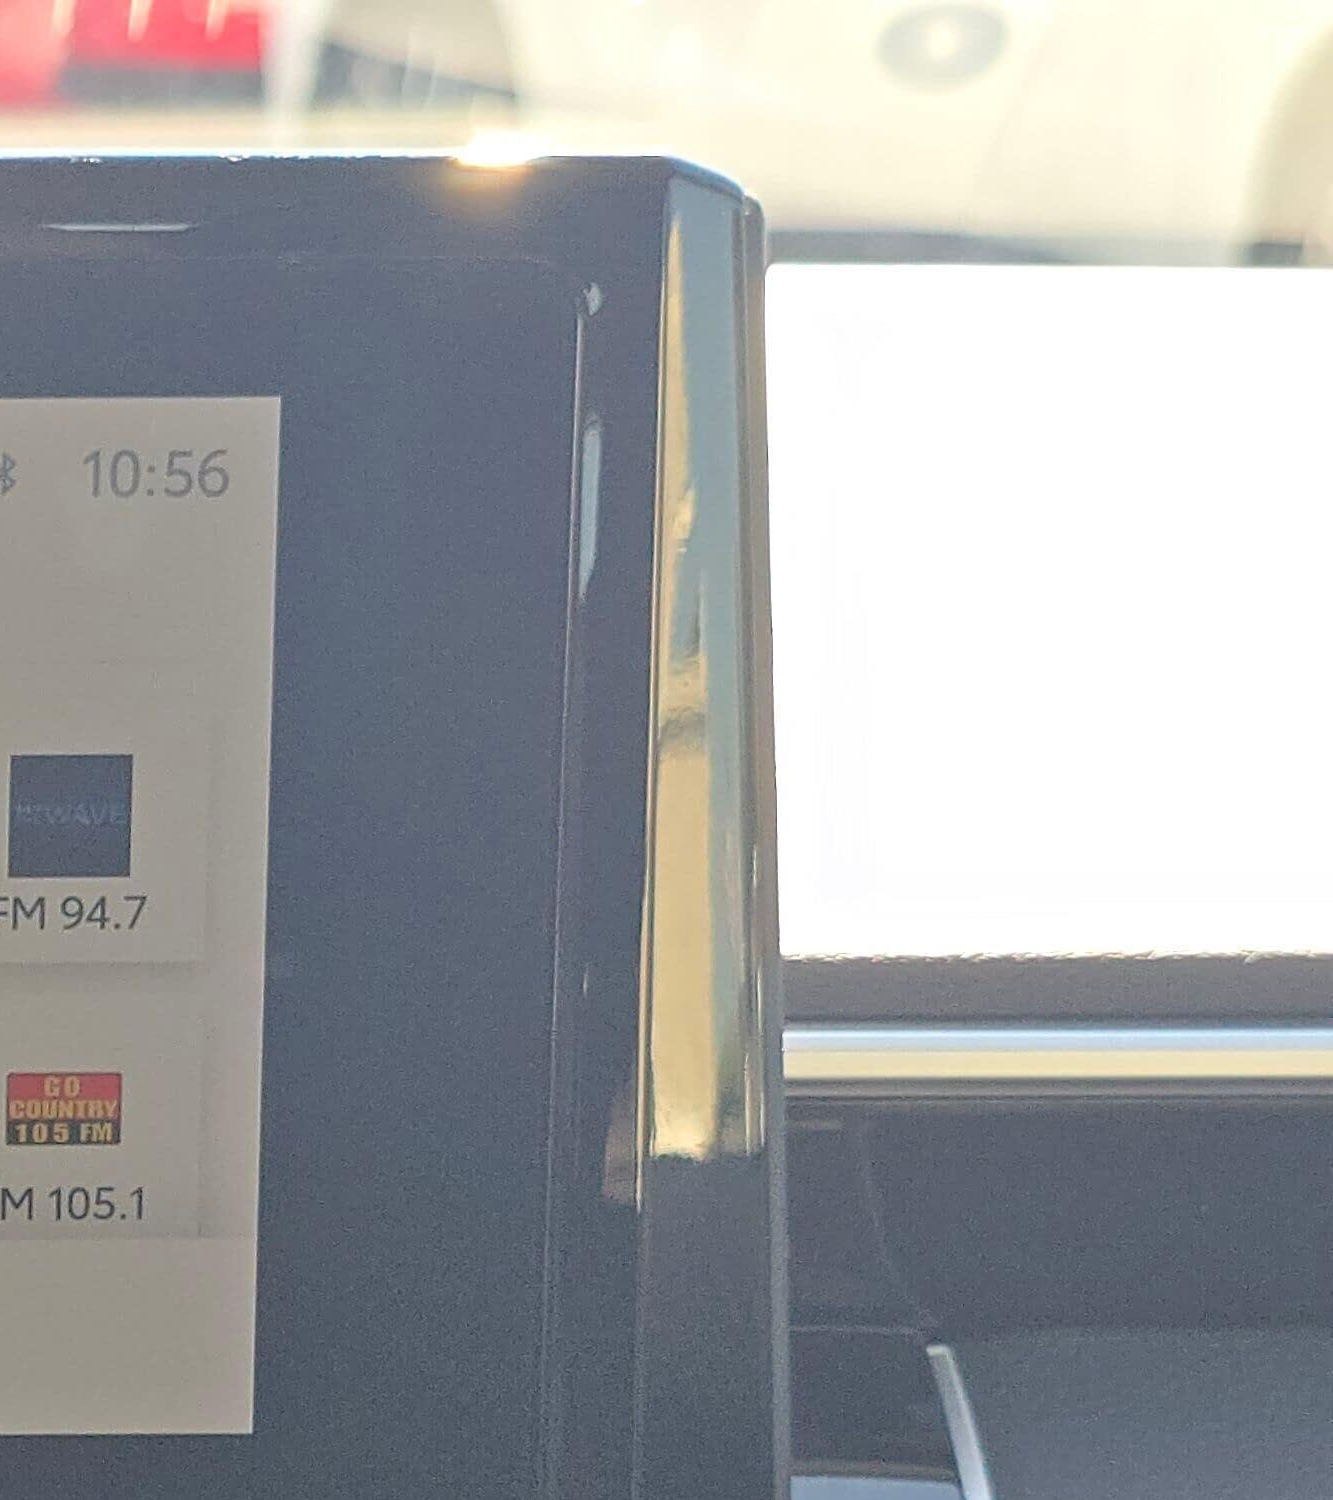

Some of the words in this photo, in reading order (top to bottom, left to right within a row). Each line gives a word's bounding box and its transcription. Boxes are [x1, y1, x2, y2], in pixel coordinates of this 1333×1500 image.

[83, 449, 230, 498] 10:56
[60, 895, 147, 930] 94.7
[44, 1075, 80, 1098] GO
[9, 1100, 117, 1120] COUNTRY
[15, 1122, 69, 1143] 105
[80, 1121, 113, 1143] FM
[49, 1186, 144, 1221] 105.1
